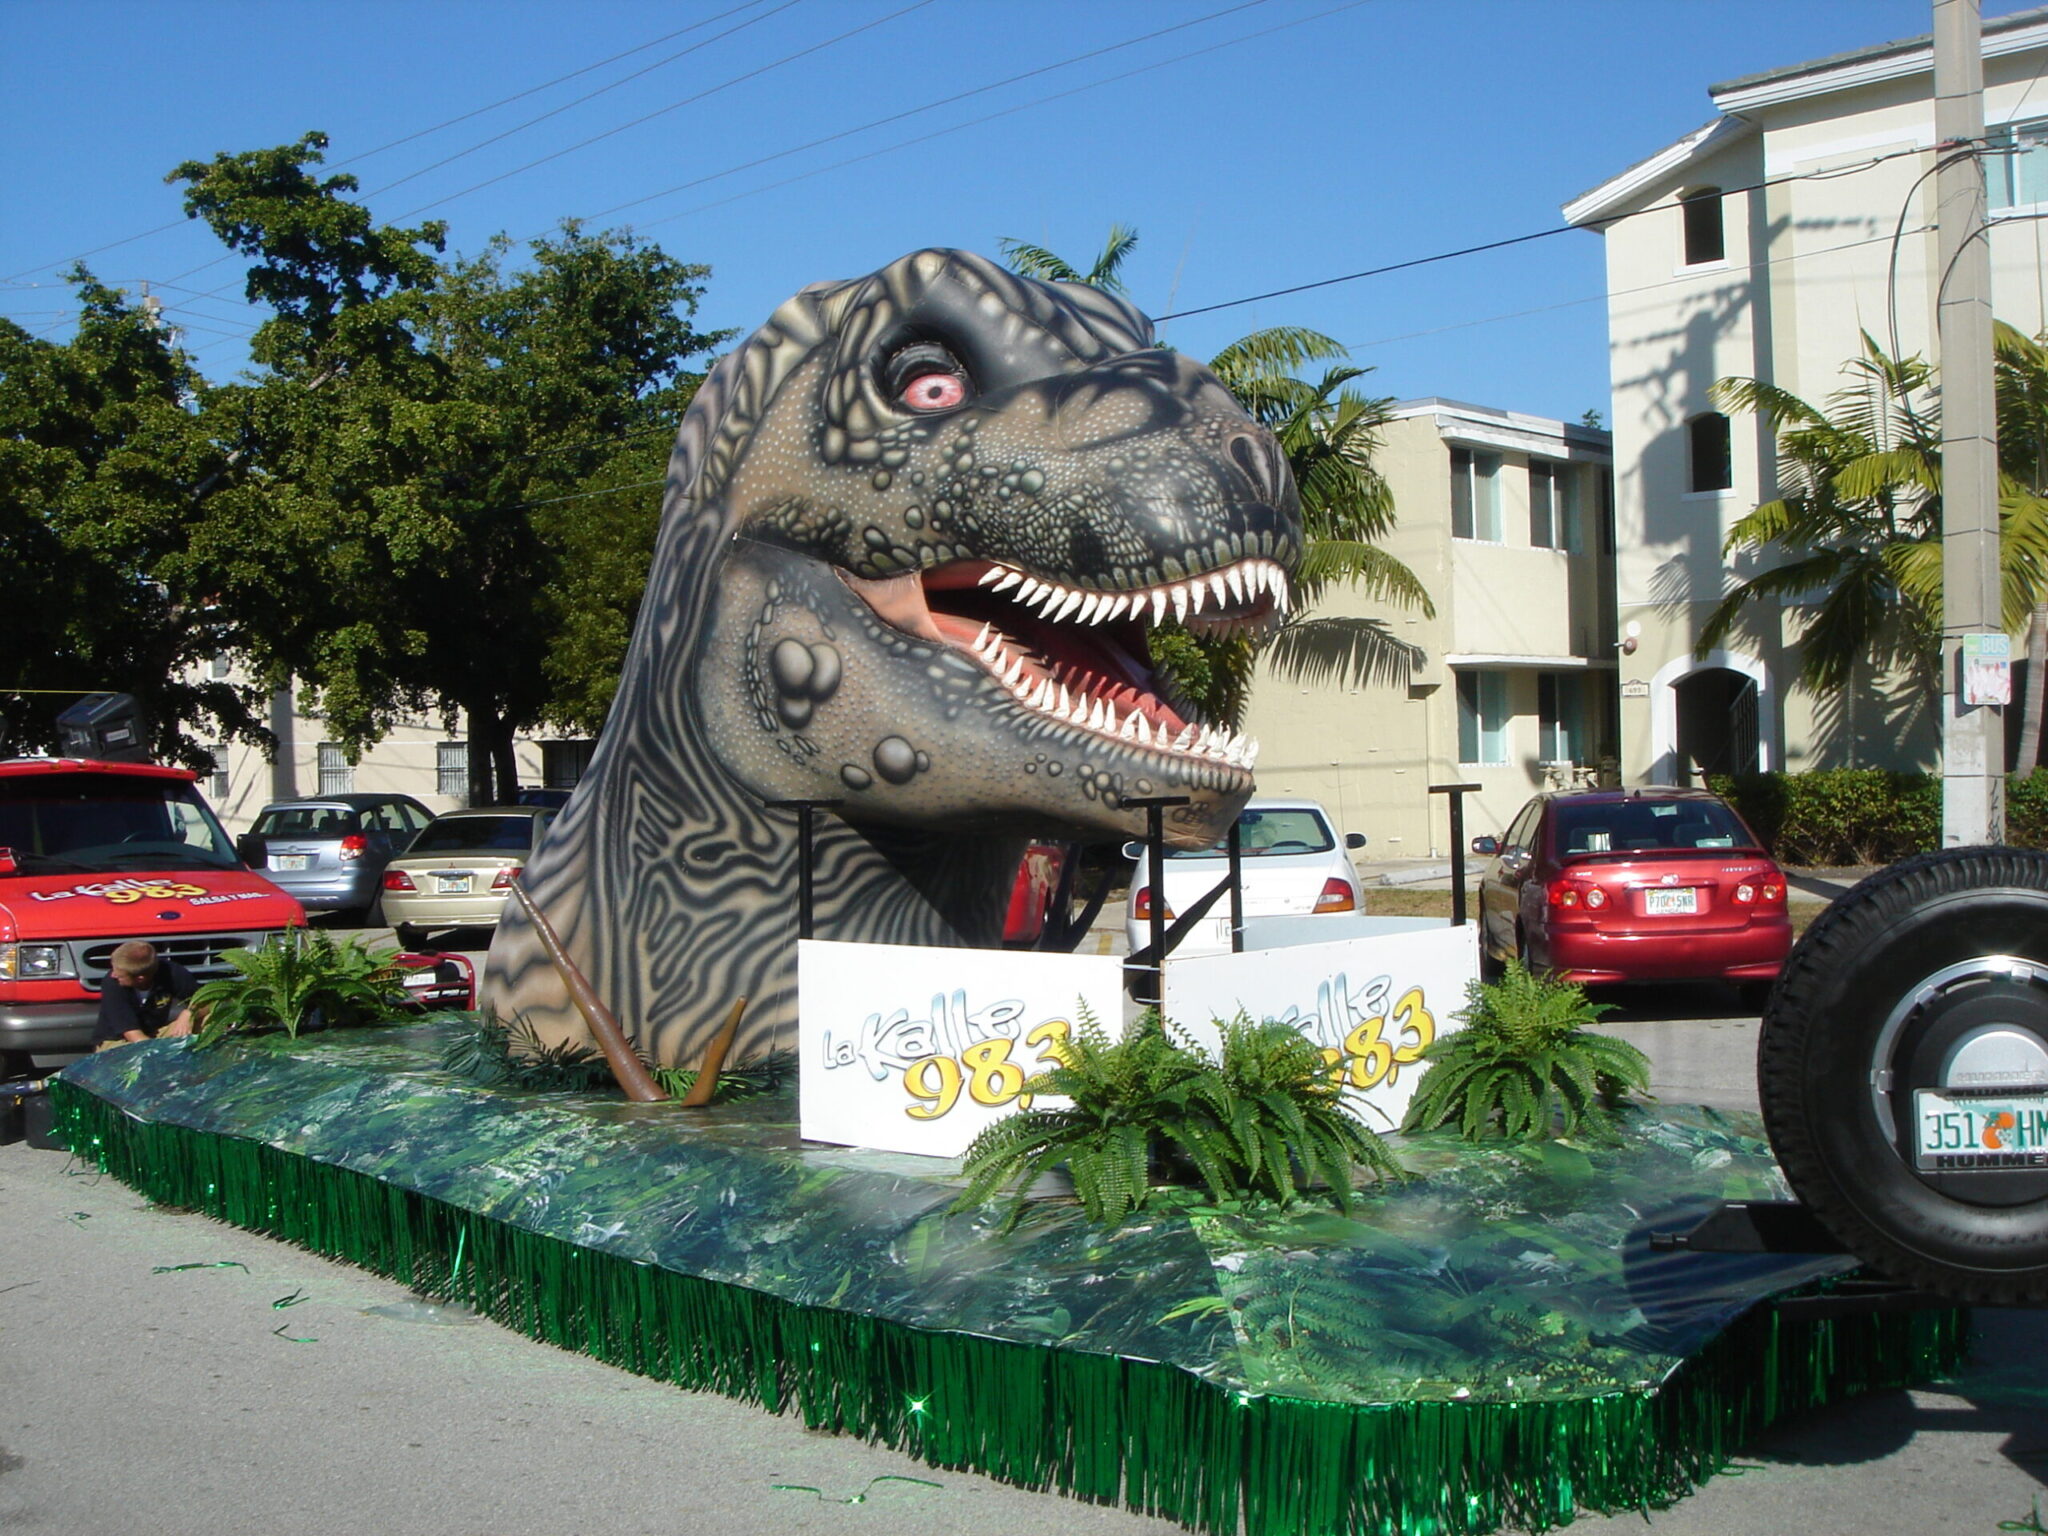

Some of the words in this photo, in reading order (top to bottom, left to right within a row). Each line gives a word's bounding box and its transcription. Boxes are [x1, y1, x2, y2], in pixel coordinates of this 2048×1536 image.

[1983, 636, 2008, 654] BUS
[30, 890, 73, 902] La
[858, 988, 1025, 1081] Kalle
[1925, 1112, 1979, 1149] 351
[1936, 1152, 2048, 1168] HUMME
